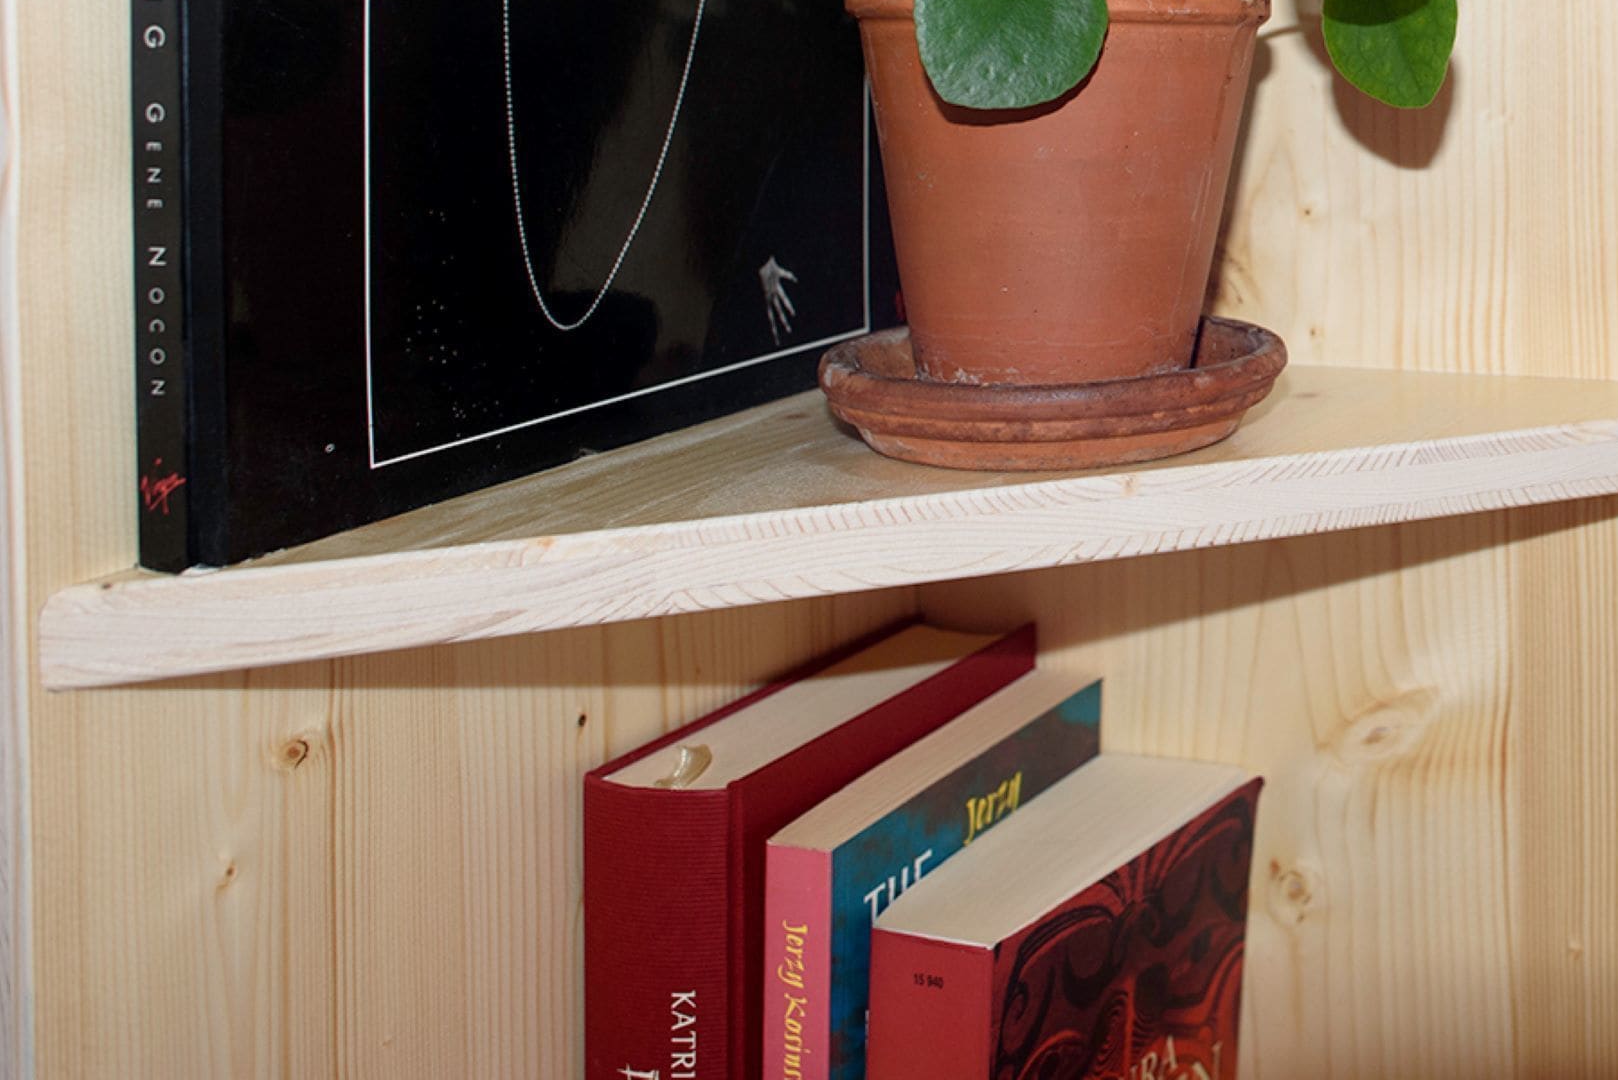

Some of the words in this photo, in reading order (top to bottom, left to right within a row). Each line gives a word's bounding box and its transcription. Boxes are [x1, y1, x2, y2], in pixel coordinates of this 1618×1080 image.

[145, 102, 165, 210] GENE
[147, 247, 167, 395] NOCON
[777, 920, 808, 988] Jerzy
[671, 990, 696, 1079] KATRI
